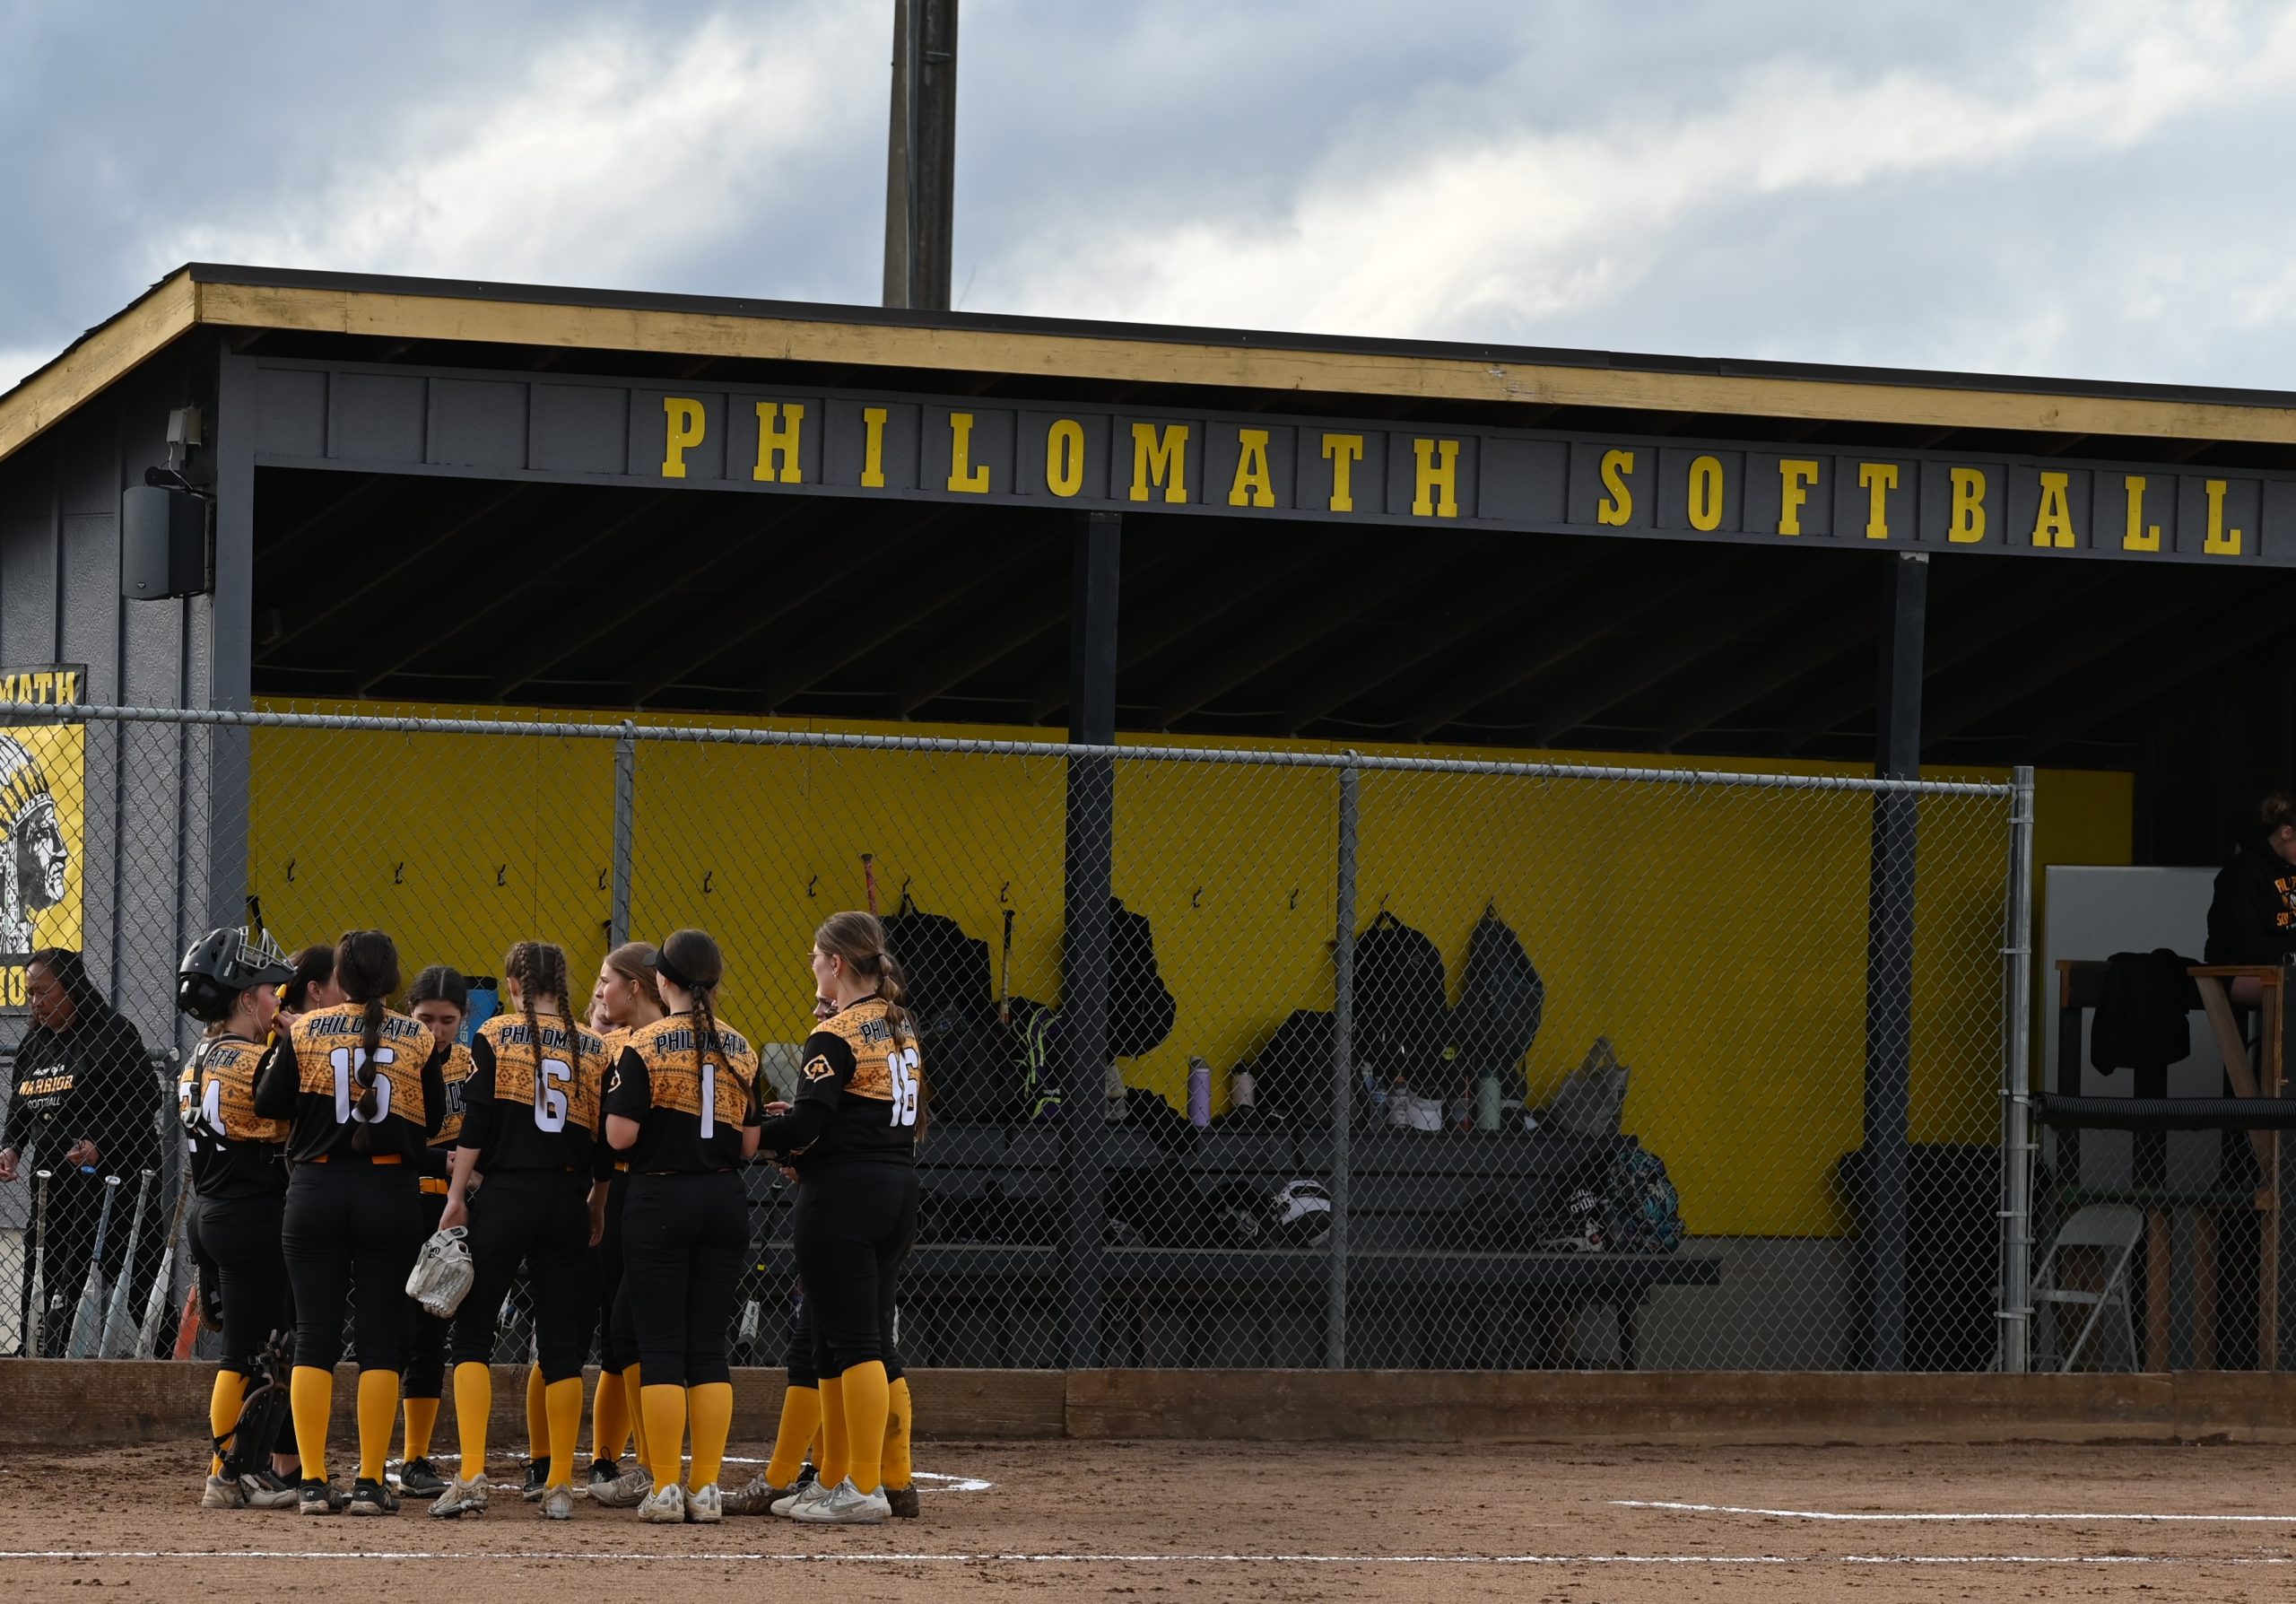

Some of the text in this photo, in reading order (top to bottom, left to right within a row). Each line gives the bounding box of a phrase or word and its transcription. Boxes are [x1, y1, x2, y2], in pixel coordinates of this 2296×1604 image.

[662, 397, 2241, 555] PHILOMATH SOFTBALL
[307, 1016, 422, 1041] PHILOATH
[499, 1025, 603, 1056] PHIOMTH
[28, 1096, 61, 1109] SOFTBALL
[329, 1047, 395, 1123] 15
[535, 1058, 571, 1132] 6
[700, 1064, 715, 1138] 1
[887, 1047, 918, 1127] 16
